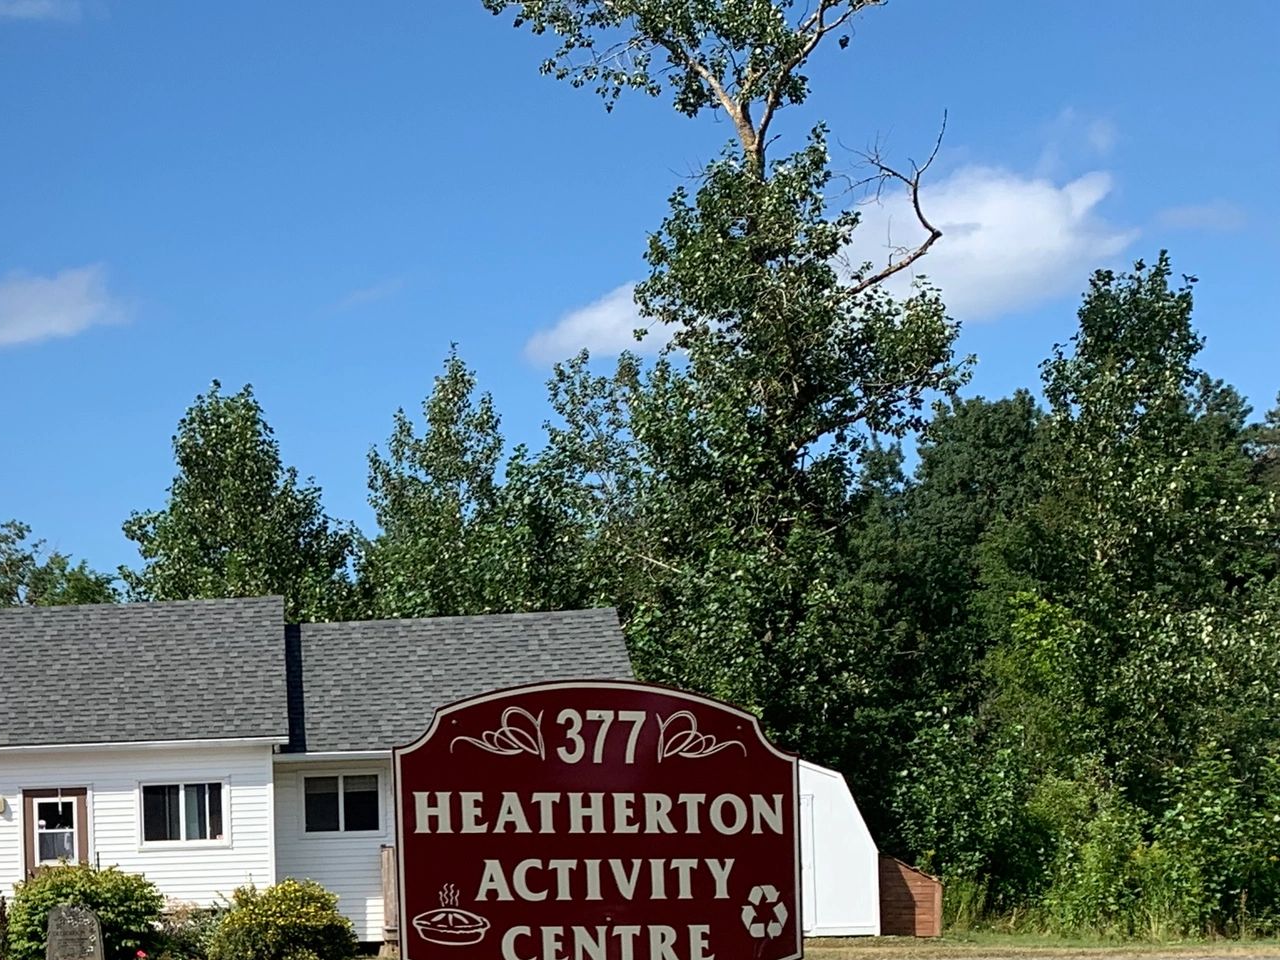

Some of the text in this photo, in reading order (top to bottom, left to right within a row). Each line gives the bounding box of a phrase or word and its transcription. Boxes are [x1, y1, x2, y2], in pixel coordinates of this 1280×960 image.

[556, 708, 647, 763] 377
[412, 791, 784, 835] HEATHERTON
[474, 858, 735, 901] ACTIVITY
